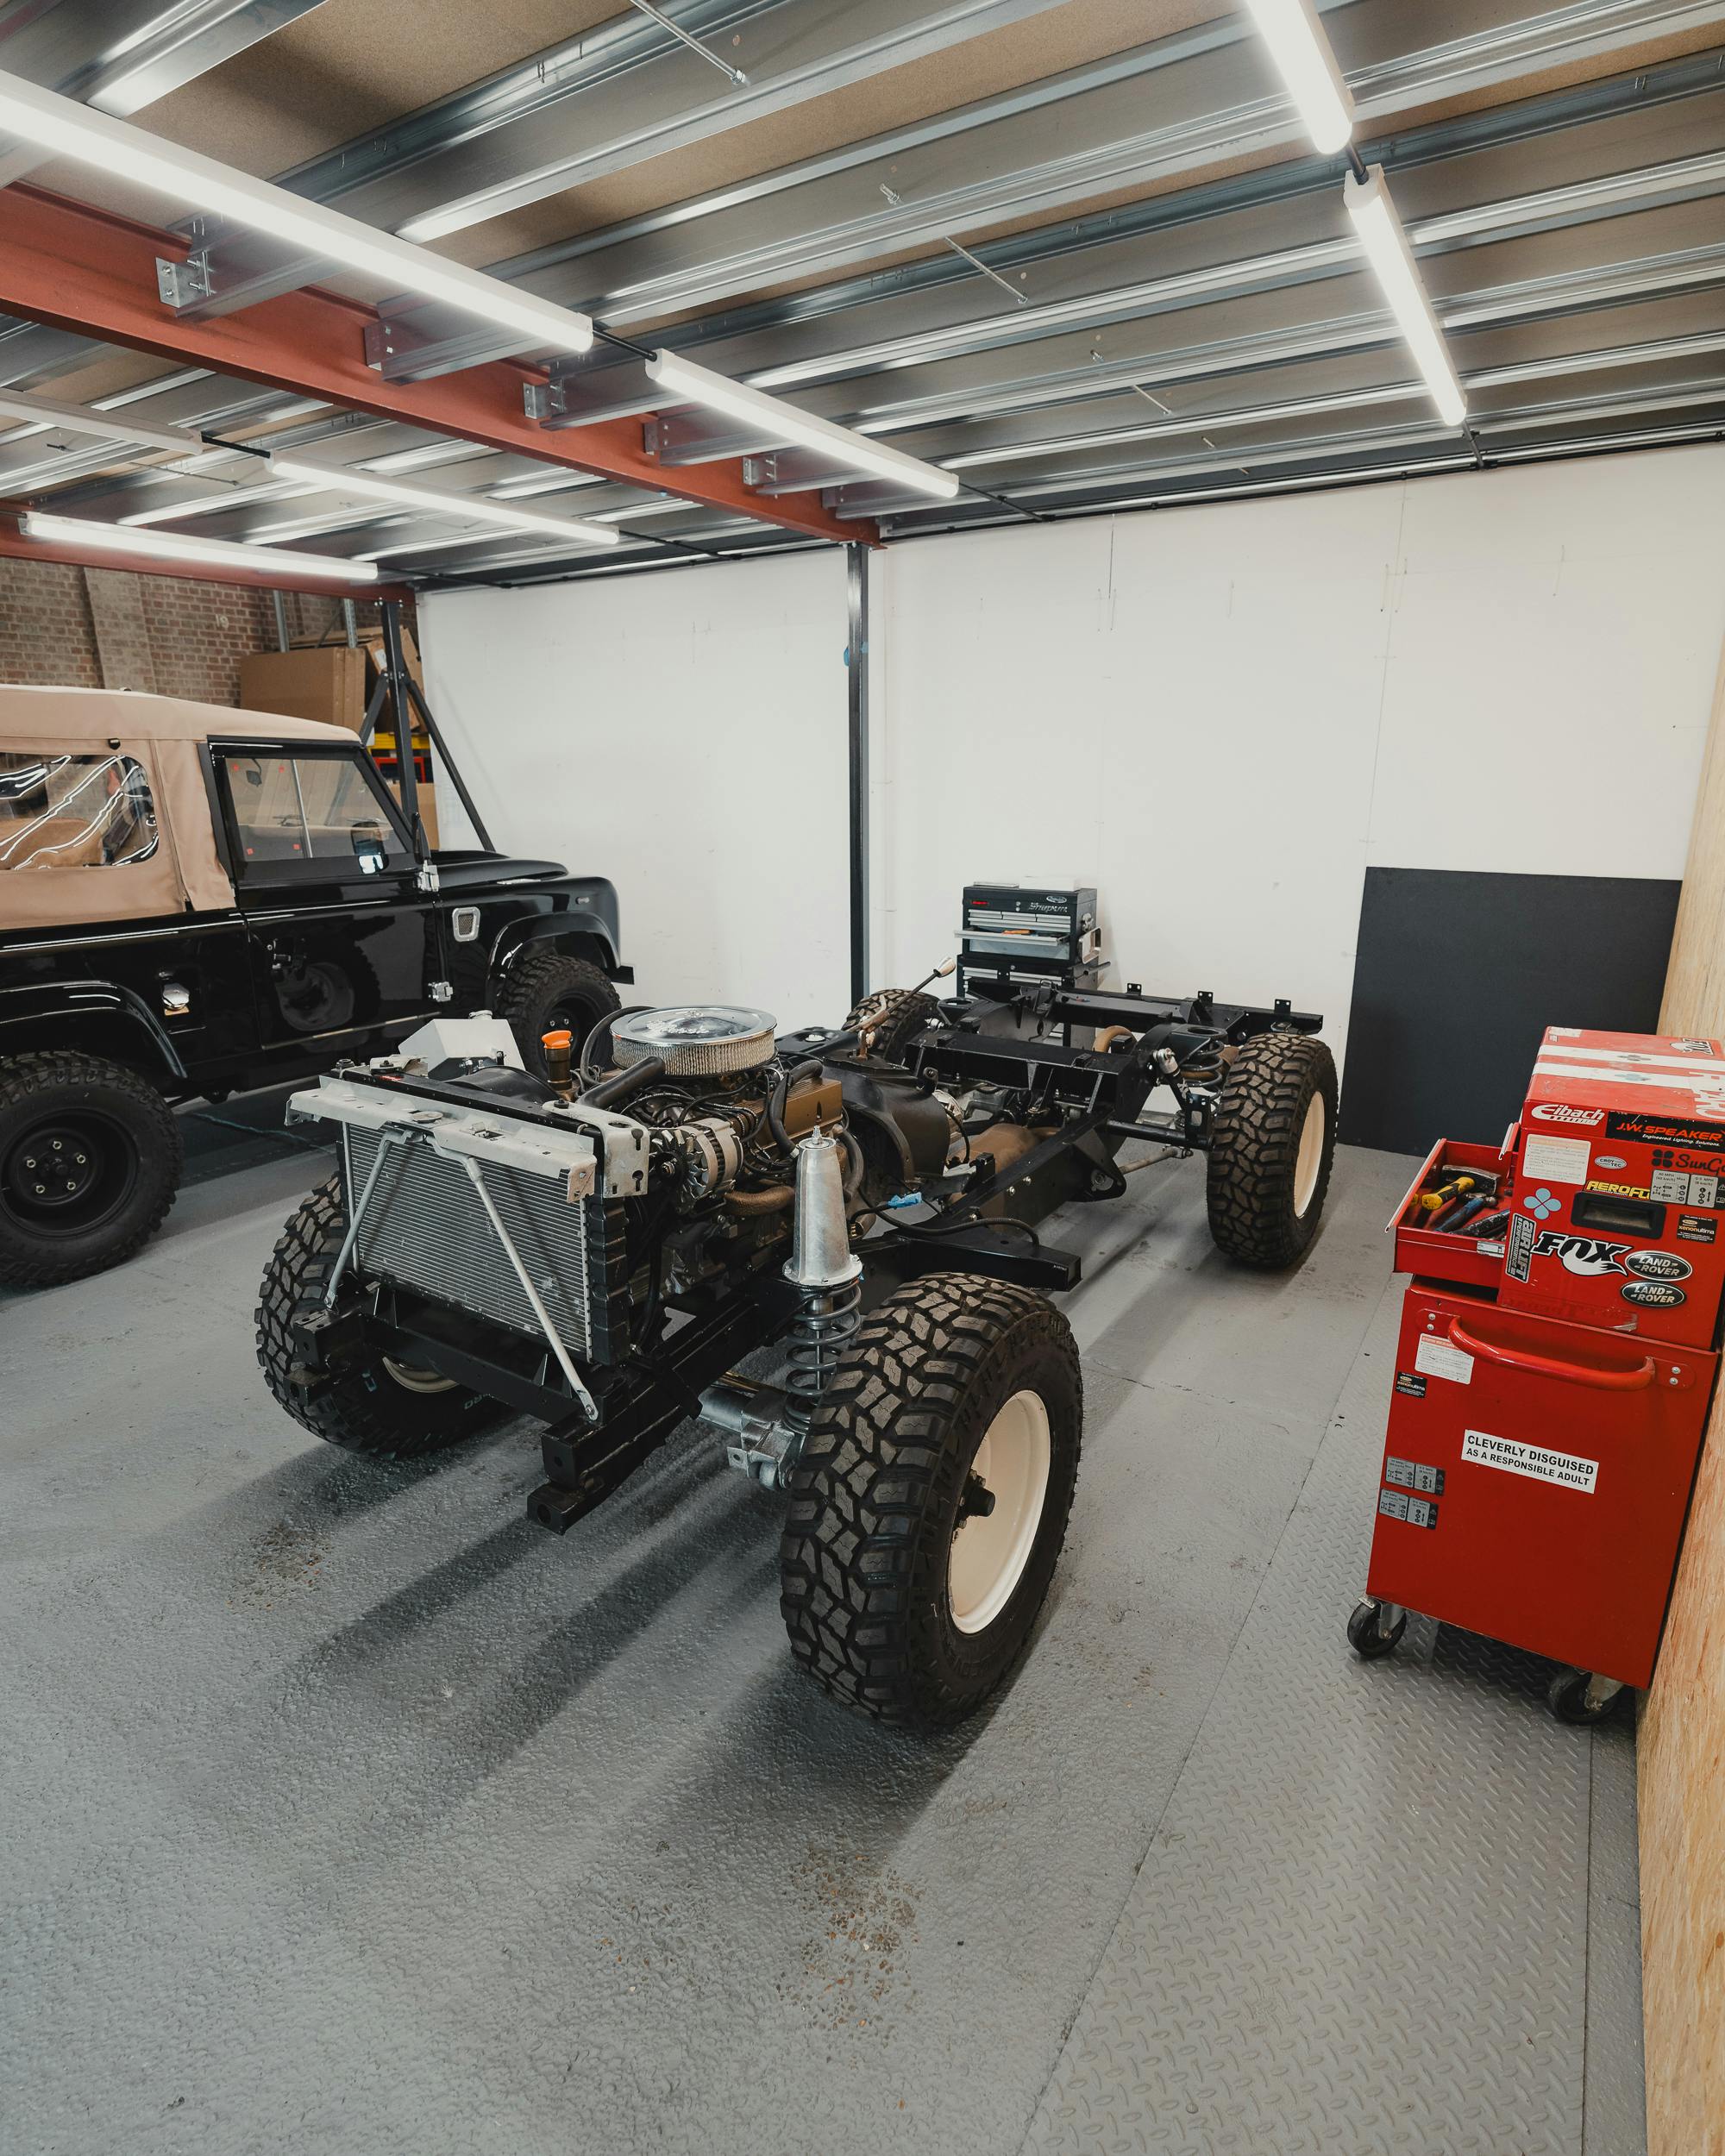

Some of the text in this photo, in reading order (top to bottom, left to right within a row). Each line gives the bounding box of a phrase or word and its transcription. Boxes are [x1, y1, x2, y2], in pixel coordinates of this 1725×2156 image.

[1532, 1104, 1605, 1121] Eibach
[1616, 1122, 1722, 1141] J.W. SPEAKER
[1678, 1225, 1715, 1235] xenonultima
[1531, 1231, 1634, 1264] FOX
[1639, 1255, 1672, 1267] LAND
[1640, 1264, 1680, 1276] ROVER
[1634, 1285, 1665, 1295] LAND
[1637, 1294, 1675, 1303] ROVER
[1467, 1435, 1594, 1475] CLEVERLY DISGUISED
[1466, 1448, 1478, 1457] AS
[1490, 1454, 1555, 1477] RESPONSIBLE
[1557, 1471, 1590, 1486] ADULT
